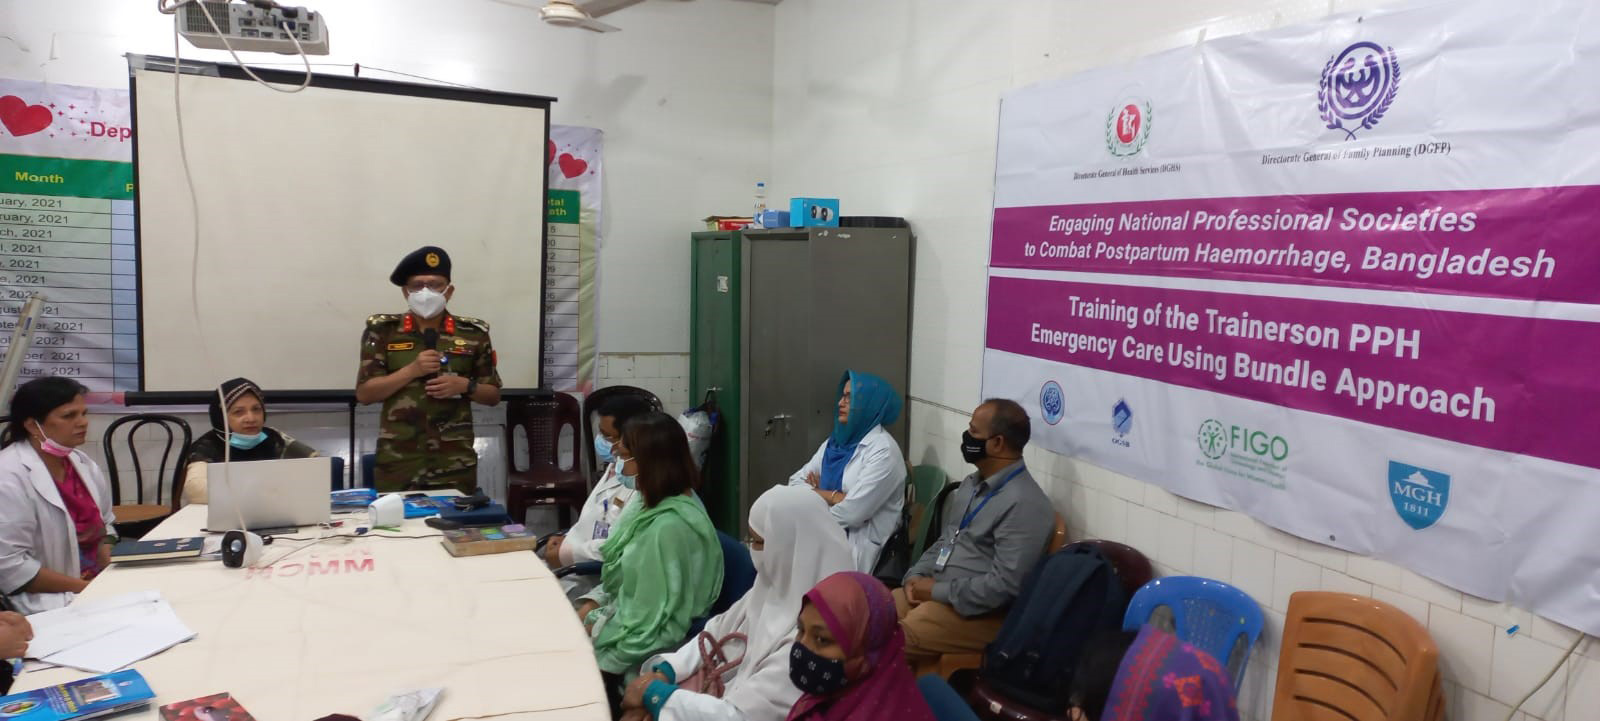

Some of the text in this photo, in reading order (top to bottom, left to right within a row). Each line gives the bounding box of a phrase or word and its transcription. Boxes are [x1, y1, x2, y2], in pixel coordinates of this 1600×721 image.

[1262, 154, 1301, 166] Directorate
[1303, 151, 1331, 163] General
[1372, 145, 1412, 158] Planning
[1413, 141, 1452, 157] (DGFP)
[15, 171, 64, 183] Month
[32, 198, 62, 208] 2021
[38, 213, 68, 224] 2021
[1049, 206, 1477, 236] Engaging National Professional Societies
[22, 228, 52, 239] 2021
[11, 243, 42, 253] 2021
[9, 259, 39, 269] 2021
[1024, 240, 1556, 279] to Combat Postpartum Haemorrhage, Bangladesh
[15, 274, 46, 285] 2021
[53, 321, 83, 331] 2021
[1069, 295, 1421, 360] Training of the Trainerson PPH
[36, 336, 66, 346] 2021
[50, 351, 81, 361] 2021
[51, 366, 81, 377] 2021
[1031, 322, 1496, 423] Emergency Care Using Bundle Approach
[1231, 425, 1289, 461] FIGO
[1393, 480, 1443, 507] MGH
[1402, 501, 1430, 518] 1811
